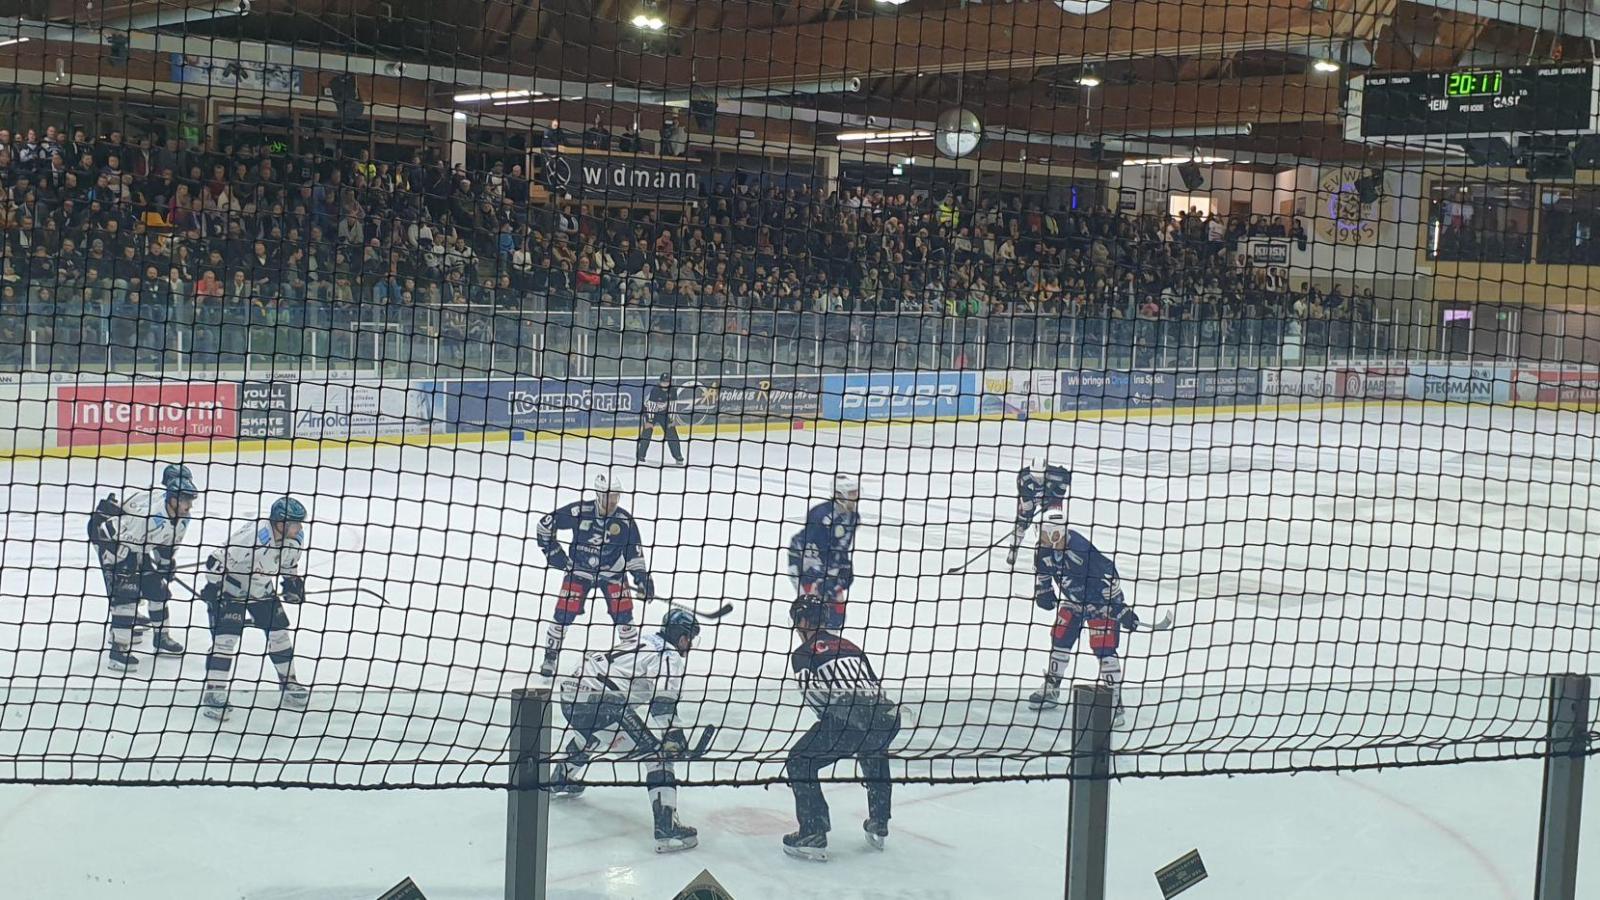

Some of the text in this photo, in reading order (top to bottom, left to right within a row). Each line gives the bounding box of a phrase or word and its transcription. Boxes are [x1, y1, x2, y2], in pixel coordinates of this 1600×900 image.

[1448, 73, 1500, 95] 20:11
[1255, 246, 1287, 256] KIOSK
[1425, 382, 1490, 394] STEGMANN
[839, 384, 957, 408] BAUER
[243, 400, 285, 408] NEVER
[70, 396, 224, 424] Internorm
[297, 402, 348, 429] Arnold
[241, 417, 284, 425] SKATE
[191, 423, 222, 434] Türen
[240, 427, 284, 436] ALONE
